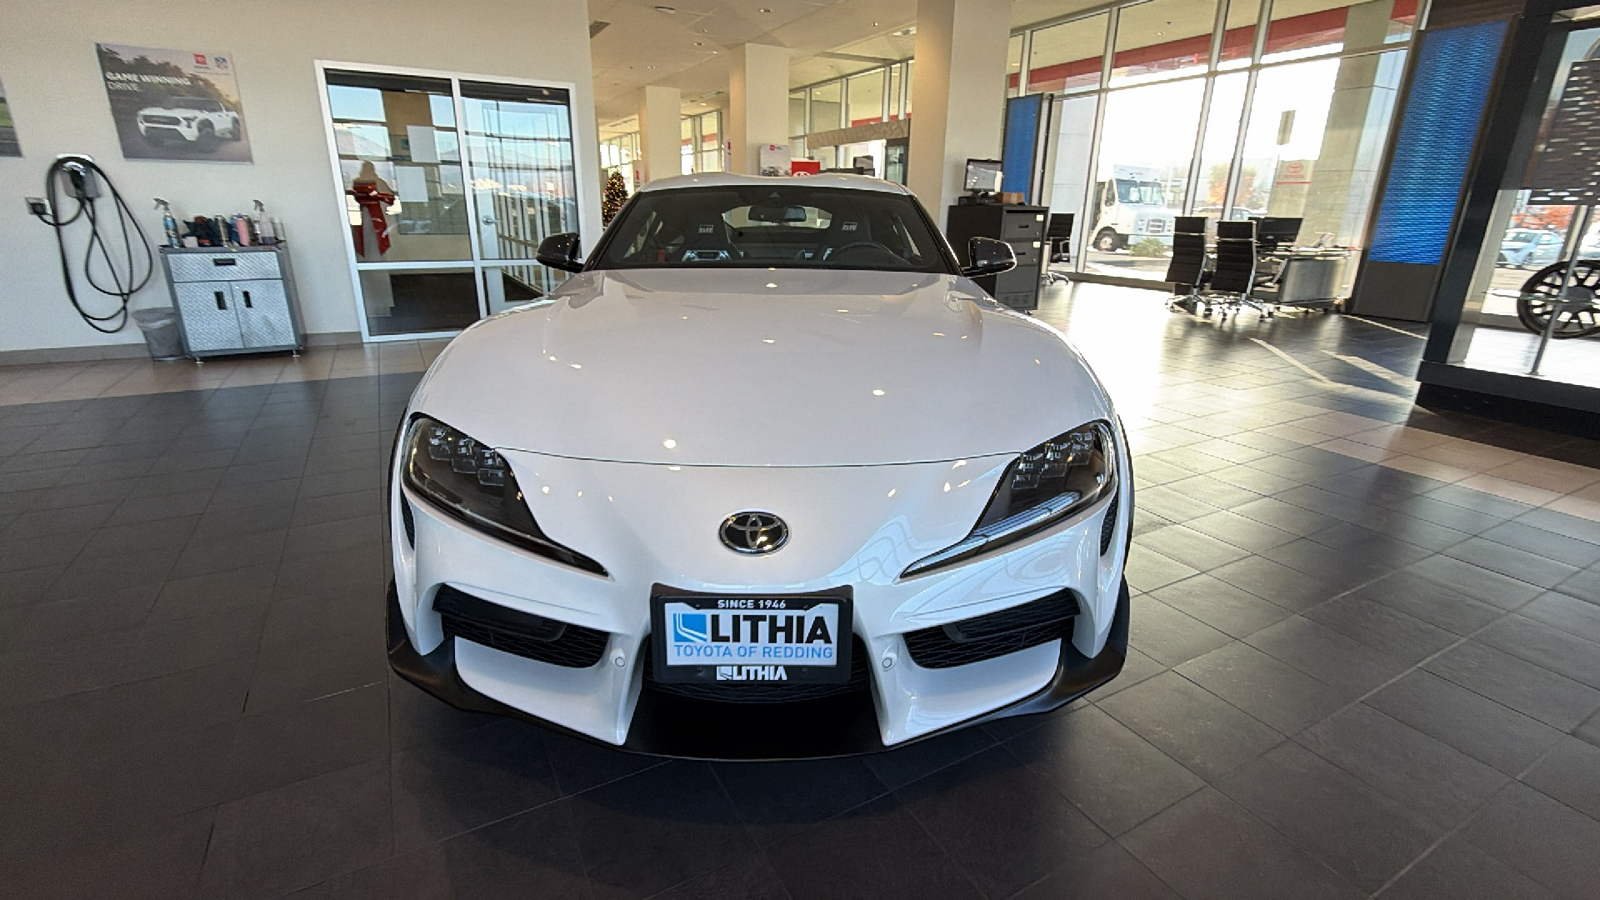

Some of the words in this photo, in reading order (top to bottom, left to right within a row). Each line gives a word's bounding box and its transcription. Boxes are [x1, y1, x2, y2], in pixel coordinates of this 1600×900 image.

[105, 71, 140, 82] GAME
[139, 73, 191, 86] WINNING
[106, 81, 141, 92] DRIVE
[717, 599, 754, 609] SINCE
[758, 599, 787, 609] 1946
[711, 614, 833, 644] LITHIA
[674, 644, 733, 658] TOYOTA
[737, 645, 757, 658] OF
[762, 646, 833, 659] REDDING
[731, 665, 788, 681] LITHIA
